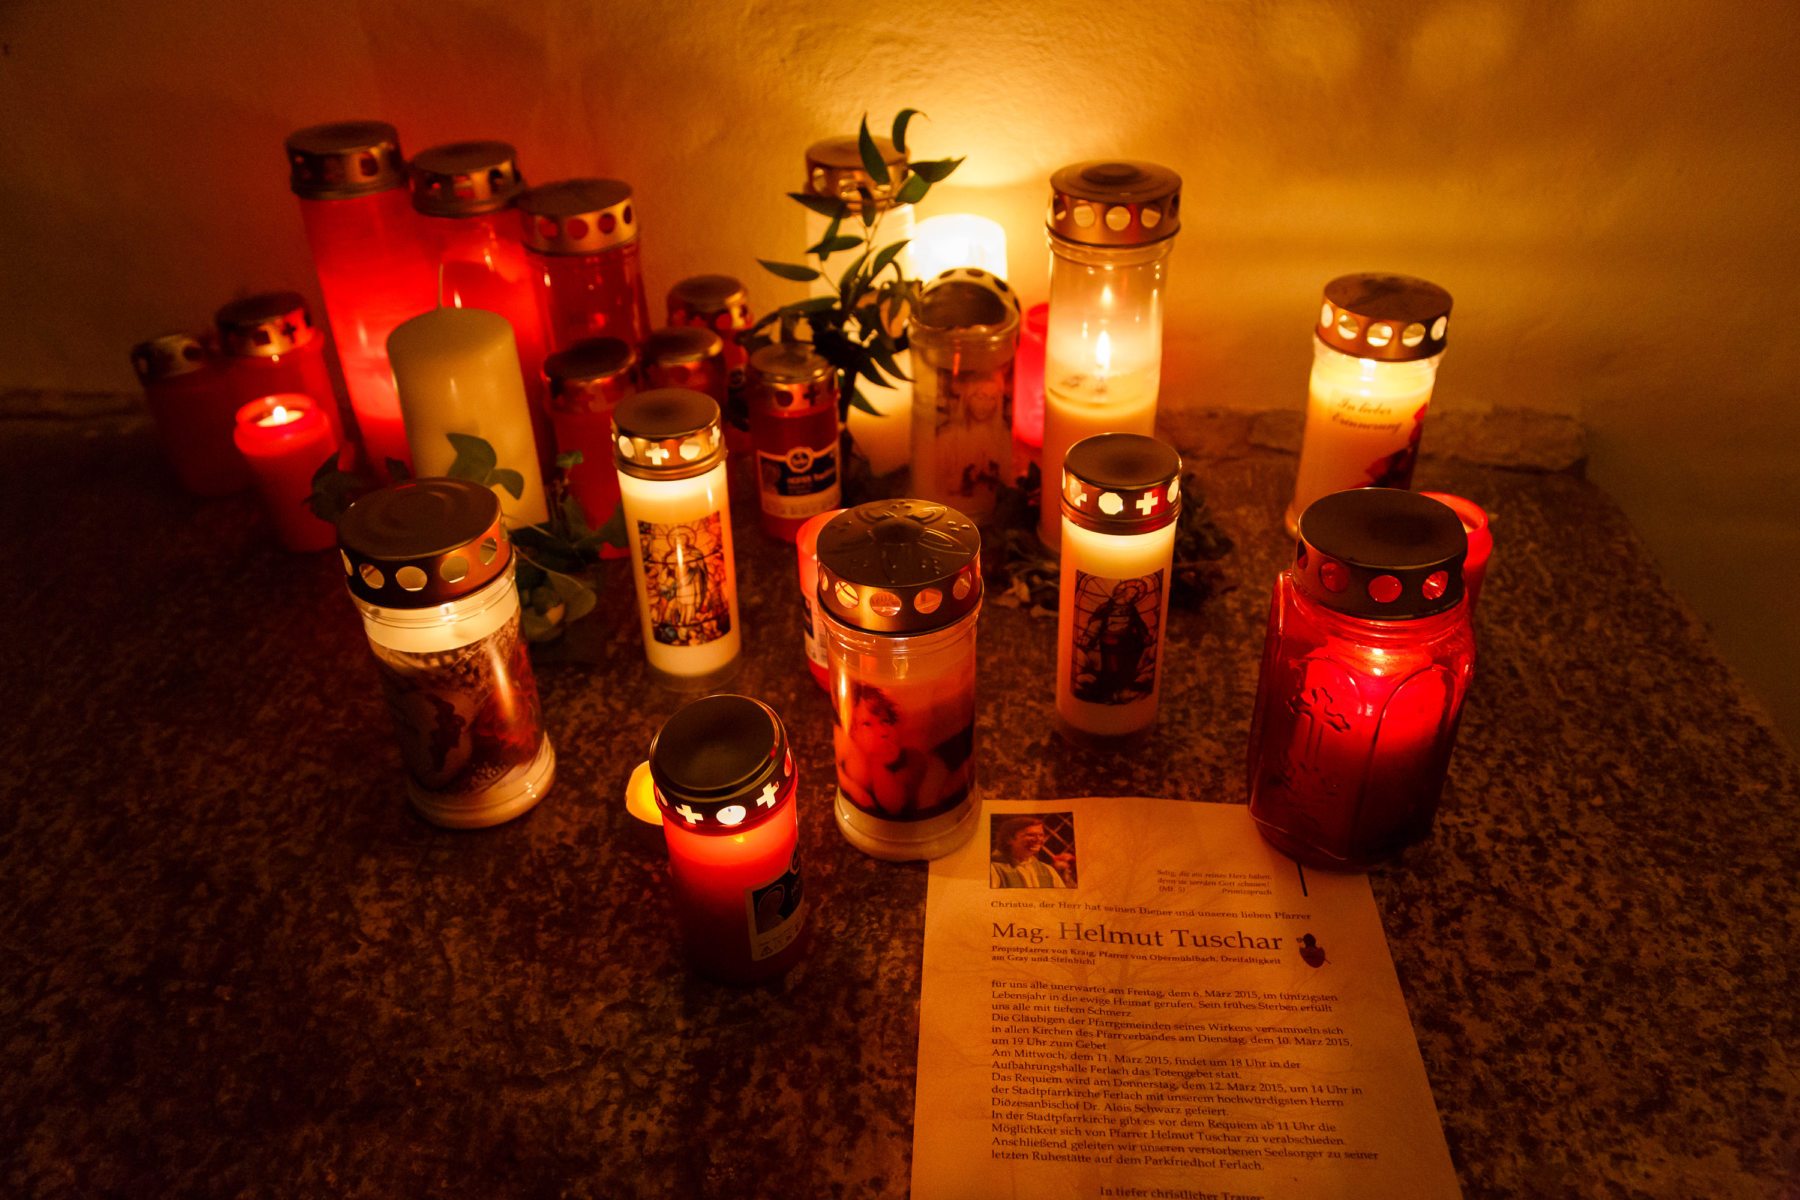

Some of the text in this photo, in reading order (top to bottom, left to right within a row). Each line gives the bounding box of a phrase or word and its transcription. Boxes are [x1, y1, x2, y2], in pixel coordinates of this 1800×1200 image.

[991, 901, 1036, 909] Christus,
[1085, 903, 1101, 911] hat
[1139, 907, 1173, 916] Diener
[1275, 912, 1312, 920] Pfarrer
[992, 922, 1282, 950] Mag. Helmut Tuschar
[992, 945, 1048, 955] Propstpfarrer
[1071, 948, 1096, 957] Kraig,
[1100, 951, 1129, 960] Pfarrer
[1221, 953, 1281, 965] Dreifaltigkeit
[992, 980, 1006, 988] für
[1030, 981, 1048, 989] alle
[1051, 984, 1105, 993] unerwartet
[1127, 988, 1165, 998] Freitag,
[1205, 990, 1230, 998] März
[1235, 991, 1260, 999] 2015,
[1279, 993, 1337, 1003] fünfzigsten
[992, 992, 1045, 1001] Lebensjahr
[1062, 993, 1078, 1002] die
[1080, 996, 1110, 1006] ewige
[1114, 997, 1150, 1006] Heimat
[1154, 1000, 1195, 1009] gerufen.
[1200, 1000, 1221, 1008] Sein
[1224, 1001, 1255, 1010] frühes
[1258, 1002, 1297, 1011] Sterben
[1301, 1004, 1332, 1012] erfüllt
[1013, 1003, 1030, 1011] alle
[1054, 1005, 1084, 1014] tiefem
[1012, 1014, 1065, 1025] Gläubigen
[1088, 1018, 1171, 1030] Pfarrgemeinden
[1209, 1023, 1252, 1032] Wirkens
[1256, 1026, 1319, 1034] versammeln
[992, 1025, 1001, 1033] in
[1005, 1025, 1029, 1033] allen
[1033, 1027, 1072, 1036] Kirchen
[1076, 1029, 1093, 1037] des
[1097, 1030, 1176, 1041] Pfarrverbandes
[1199, 1034, 1246, 1045] Dienstag,
[1251, 1036, 1273, 1044] dem
[1295, 1036, 1322, 1045] März
[1325, 1038, 1352, 1047] 2015,
[1027, 1038, 1046, 1046] Uhr
[1014, 1050, 1066, 1060] Mittwoch,
[1070, 1052, 1093, 1061] dem
[1115, 1055, 1143, 1064] März
[1145, 1056, 1172, 1065] 2015,
[1175, 1057, 1207, 1066] findet
[1231, 1059, 1242, 1067] 18
[1246, 1059, 1265, 1068] Uhr
[1270, 1060, 1279, 1068] in
[1283, 1060, 1301, 1069] der
[992, 1061, 1241, 1080] Aufbahrungshalle Ferlach das Totengebet statt.
[992, 1073, 1011, 1082] Das
[1015, 1073, 1062, 1084] Requiem
[1065, 1076, 1090, 1085] wird
[1114, 1079, 1179, 1091] Donnerstag,
[1182, 1081, 1206, 1090] dem
[1227, 1082, 1255, 1092] März
[1259, 1083, 1287, 1093] 2015,
[1312, 1085, 1323, 1093] 14
[1326, 1085, 1347, 1094] Uhr
[1352, 1086, 1362, 1095] in
[992, 1085, 1344, 1107] der Stadtpfarrkirche Ferlach mit unserem hochwürdigsten Herrn
[992, 1098, 1229, 1118] Diözesanbischof Dr. Alois Schwarz gefeiert.
[992, 1110, 1002, 1119] In
[1006, 1111, 1022, 1120] der
[1027, 1112, 1116, 1124] Stadtpfarrkirche
[1120, 1116, 1141, 1127] gibt
[1180, 1119, 1204, 1127] dem
[1208, 1119, 1257, 1132] Requiem
[1261, 1120, 1274, 1130] ab
[1278, 1122, 1288, 1130] 11
[1293, 1121, 1315, 1131] Uhr
[1318, 1122, 1336, 1132] die
[992, 1123, 1057, 1135] Möglichkeit
[1060, 1126, 1082, 1136] sich
[1109, 1129, 1146, 1138] Pfarrer
[1151, 1130, 1194, 1140] Helmut
[1197, 1131, 1241, 1142] Tuschar
[992, 1137, 1067, 1149] Anschließend
[1071, 1140, 1113, 1151] geleiten
[1140, 1146, 1185, 1154] unseren
[1189, 1146, 1262, 1157] verstorbenen
[1265, 1148, 1323, 1160] Seelsorger
[1345, 1151, 1378, 1160] seiner
[992, 1151, 1264, 1170] letzten Ruhestätte auf dem Parkfriedhof Ferlach.
[1100, 1187, 1113, 1196] In
[1116, 1187, 1147, 1198] tiefer
[1150, 1188, 1218, 1200] christlicher
